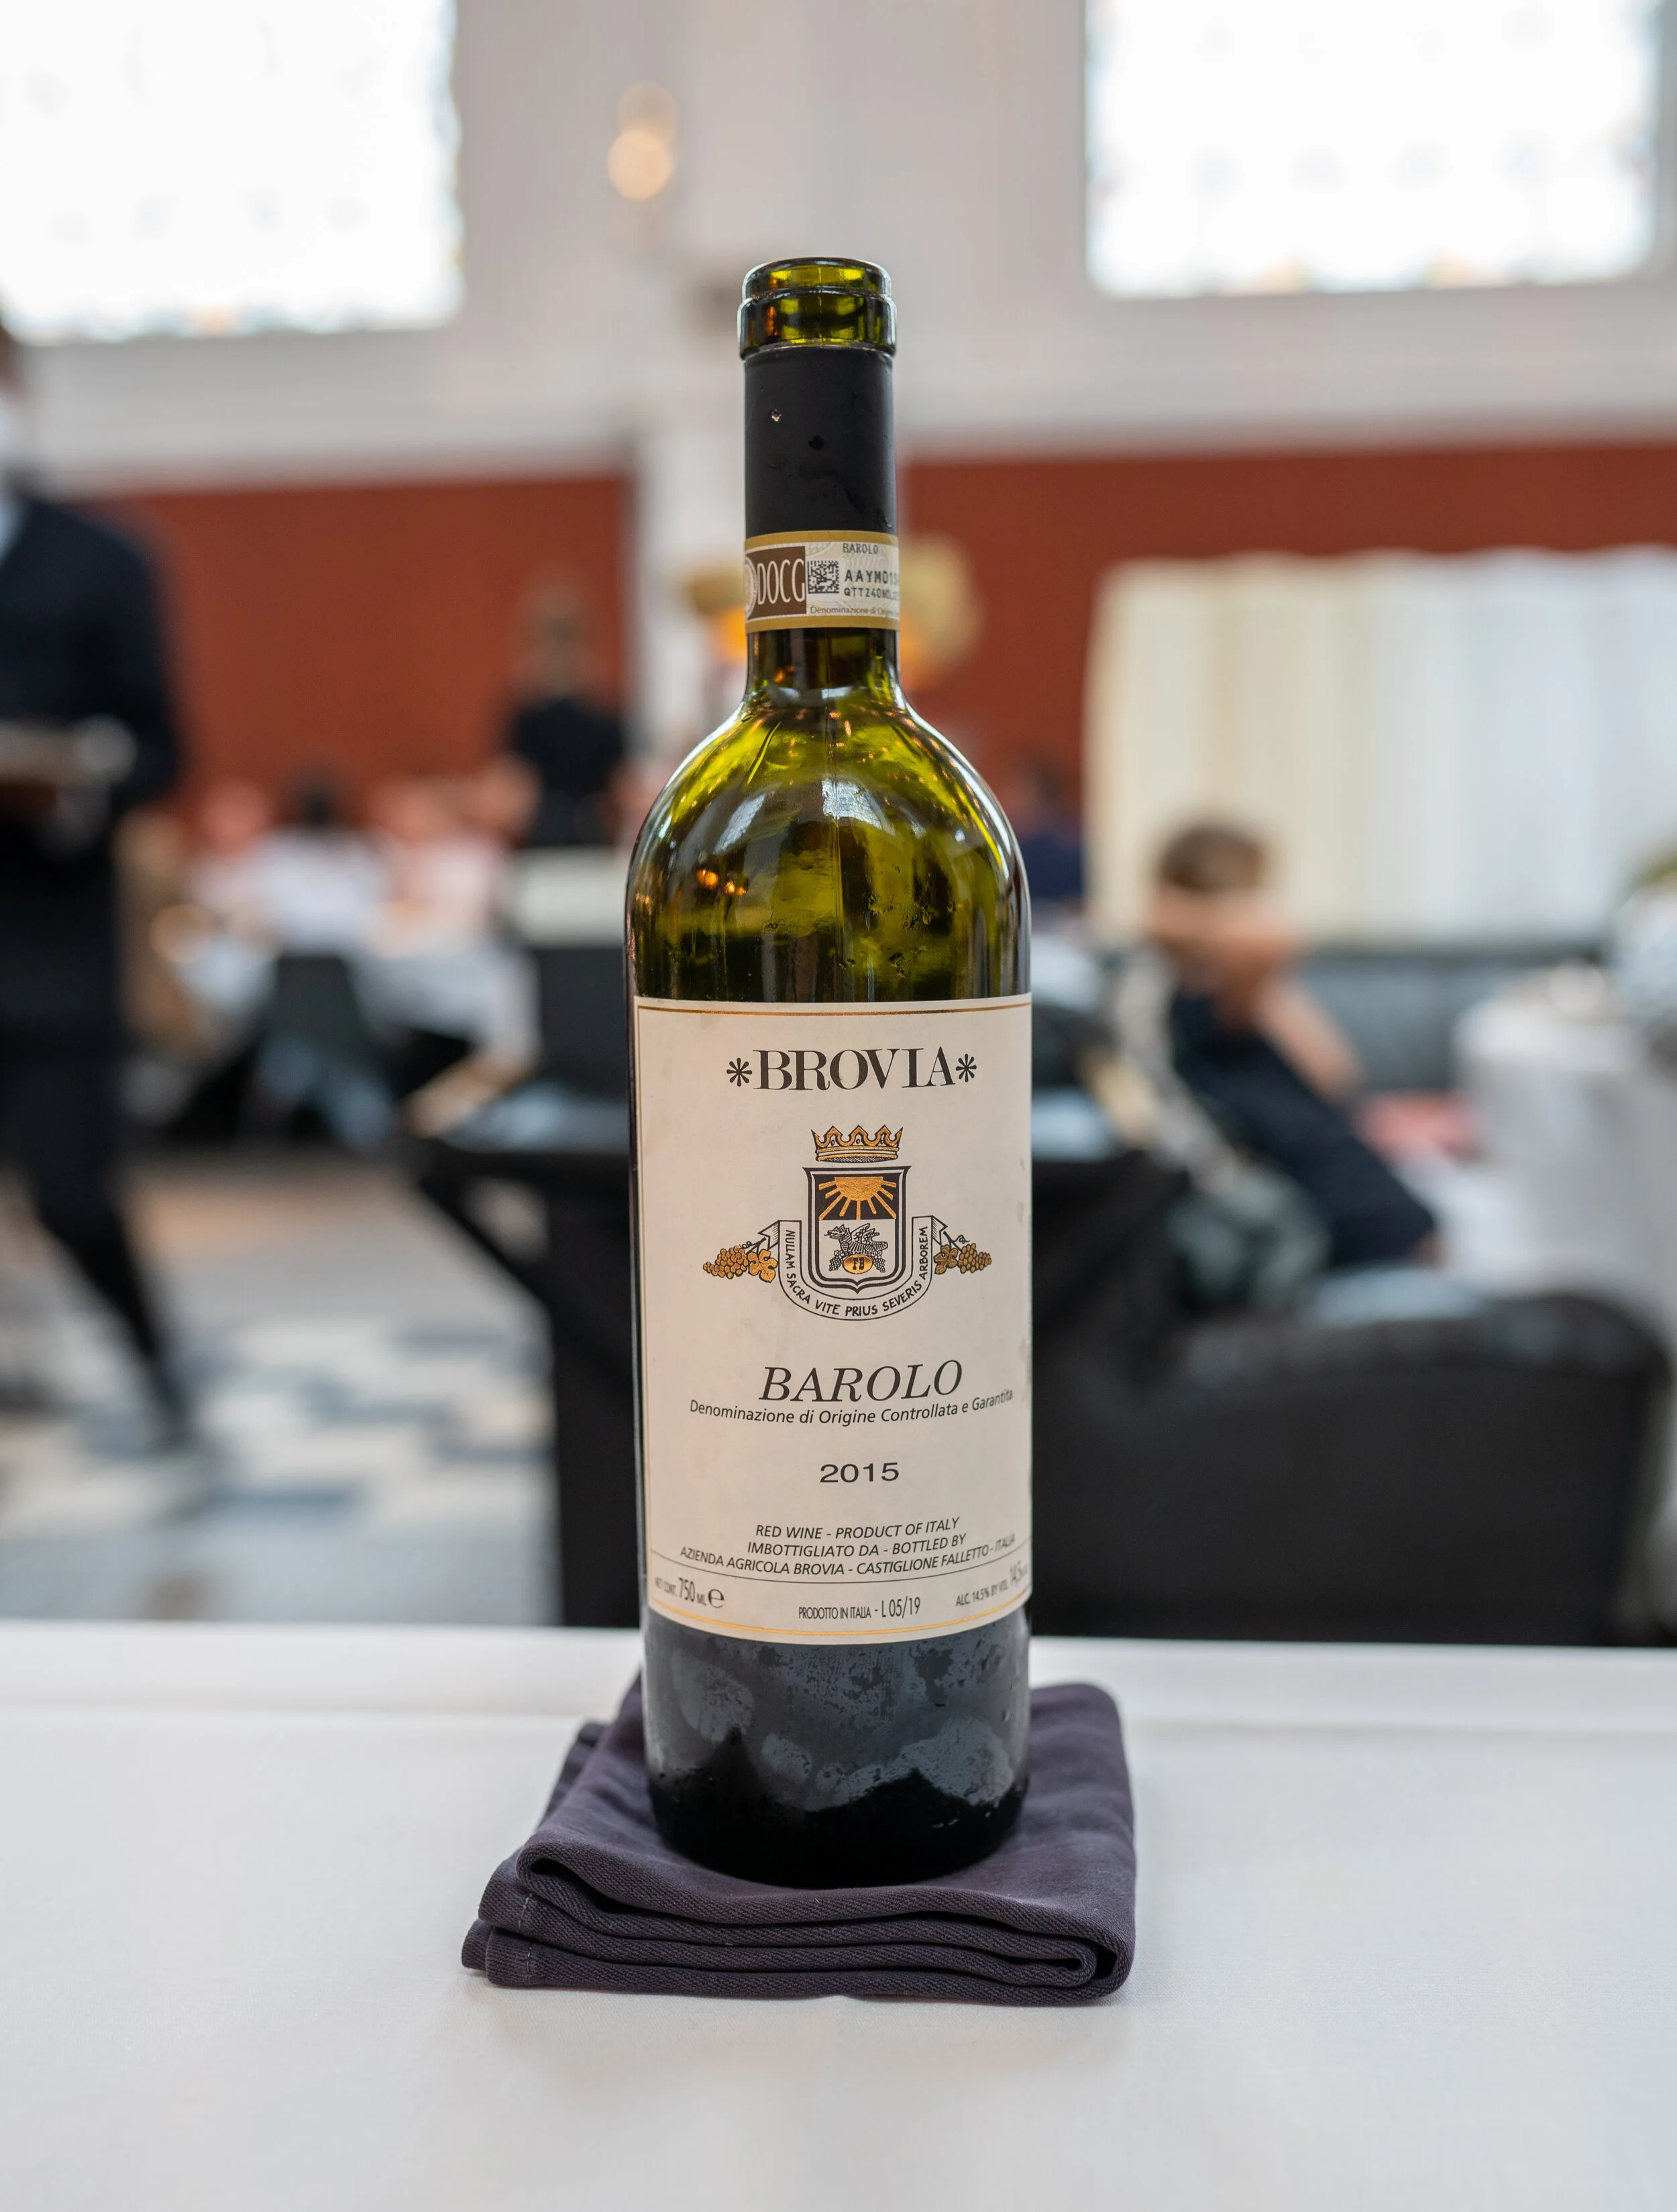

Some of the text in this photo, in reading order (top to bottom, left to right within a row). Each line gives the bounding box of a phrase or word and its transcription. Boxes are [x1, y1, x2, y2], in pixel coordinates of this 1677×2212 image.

[843, 543, 879, 555] BAROLO
[757, 558, 805, 605] DOCG
[810, 606, 868, 614] Denominazione
[752, 1046, 957, 1091] BROVIA
[785, 1226, 929, 1317] NULLAM SACRA VITE PRIUS SEVERIS ARBOREM
[759, 1360, 963, 1402] BAROLO
[690, 1388, 1014, 1427] Denominazione di Origine Controllata e Garantita
[820, 1461, 900, 1484] 2015
[755, 1525, 782, 1537] RED
[786, 1527, 823, 1539] WINE
[835, 1525, 902, 1539] PRODUCT
[906, 1523, 923, 1535] OF
[925, 1516, 961, 1534] ITALY
[680, 1546, 724, 1567] AZIENDA
[726, 1557, 790, 1574] AGRICOLA
[793, 1563, 845, 1575] BROVIA
[857, 1556, 939, 1575] CASTIGLIONE
[940, 1544, 989, 1567] FALLETTO
[995, 1533, 1016, 1553] ITALIA
[747, 1542, 855, 1557] IMBOTTIGLIATO
[859, 1545, 879, 1557] DA
[892, 1537, 949, 1555] BOTTLED
[951, 1533, 967, 1547] BY
[678, 1577, 696, 1602] 750
[798, 1606, 838, 1619] PRODOTTO
[840, 1607, 848, 1619] IN
[850, 1606, 871, 1619] ITALIA
[881, 1600, 886, 1618] L
[889, 1596, 920, 1618] 05/19
